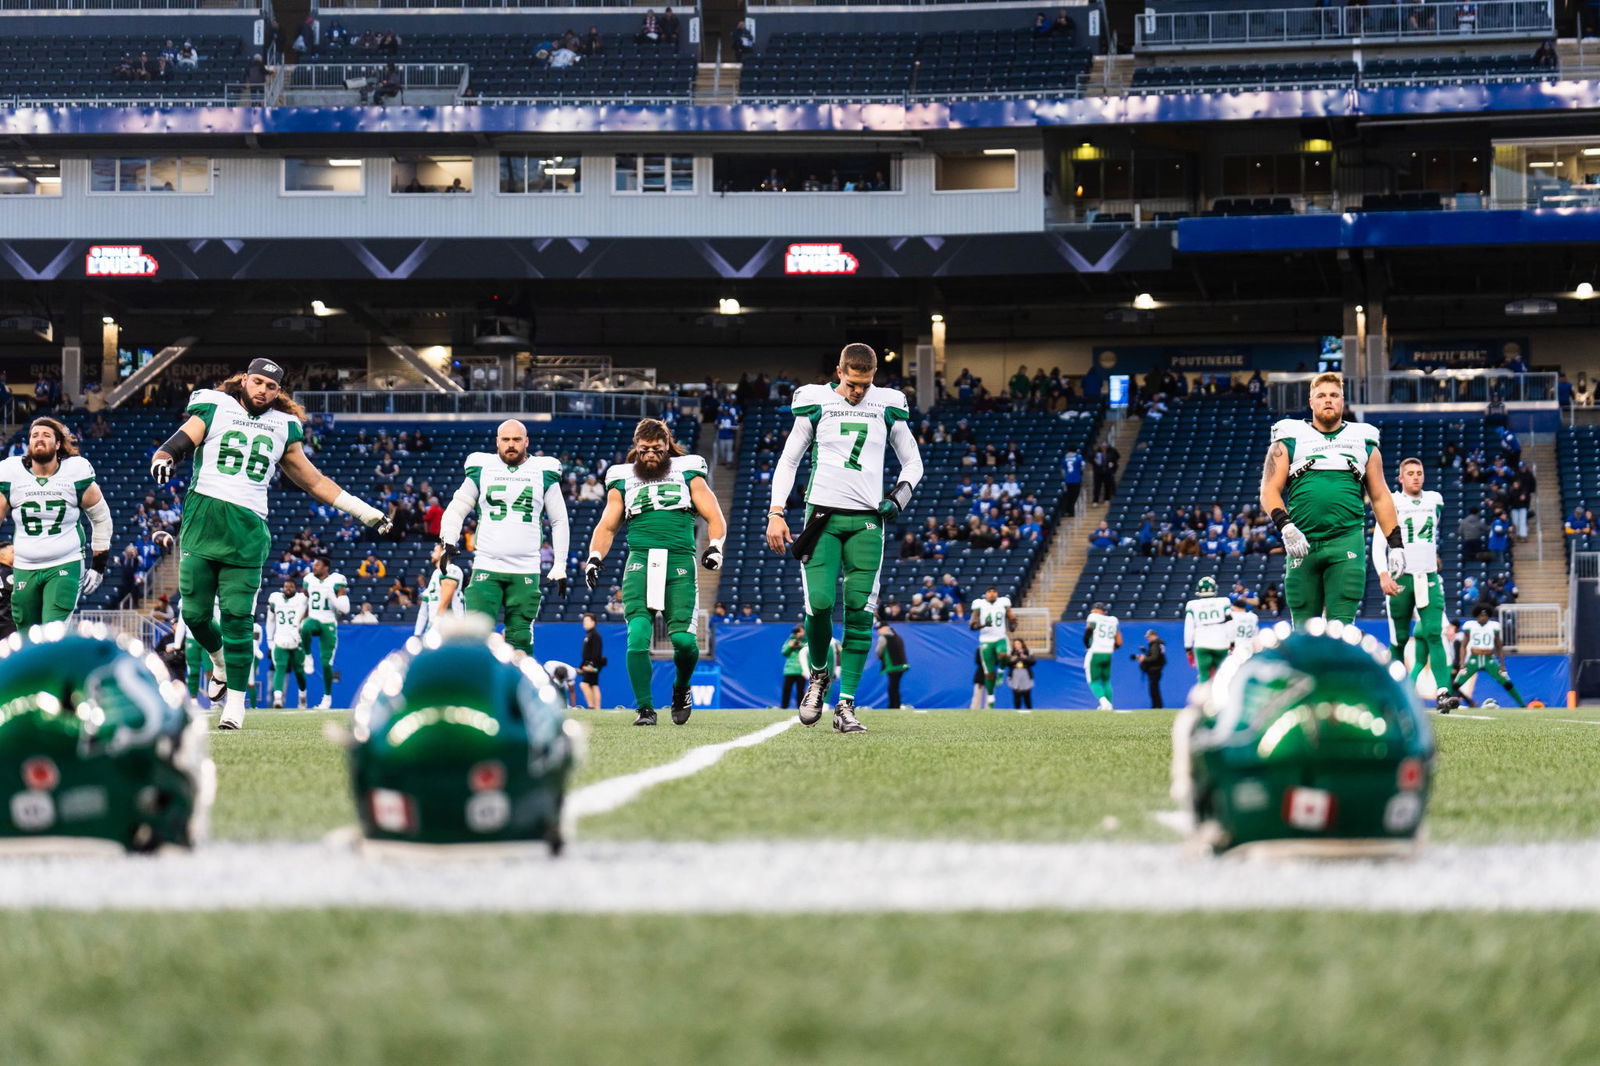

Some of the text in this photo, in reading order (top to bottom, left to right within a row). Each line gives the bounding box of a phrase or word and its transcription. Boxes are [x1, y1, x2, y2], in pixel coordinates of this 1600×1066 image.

[1171, 355, 1244, 366] POUTINERIE
[30, 364, 97, 376] BURRS
[829, 410, 878, 419] SASKATCHEWAN
[232, 419, 275, 433] SASKATCHEWAN
[840, 422, 868, 471] 7
[217, 430, 274, 482] 66
[486, 485, 533, 523] 54
[20, 500, 67, 536] 67
[1404, 516, 1434, 543] 14
[276, 610, 296, 625] 32
[1236, 624, 1255, 638] 92
[1472, 633, 1491, 646] 50
